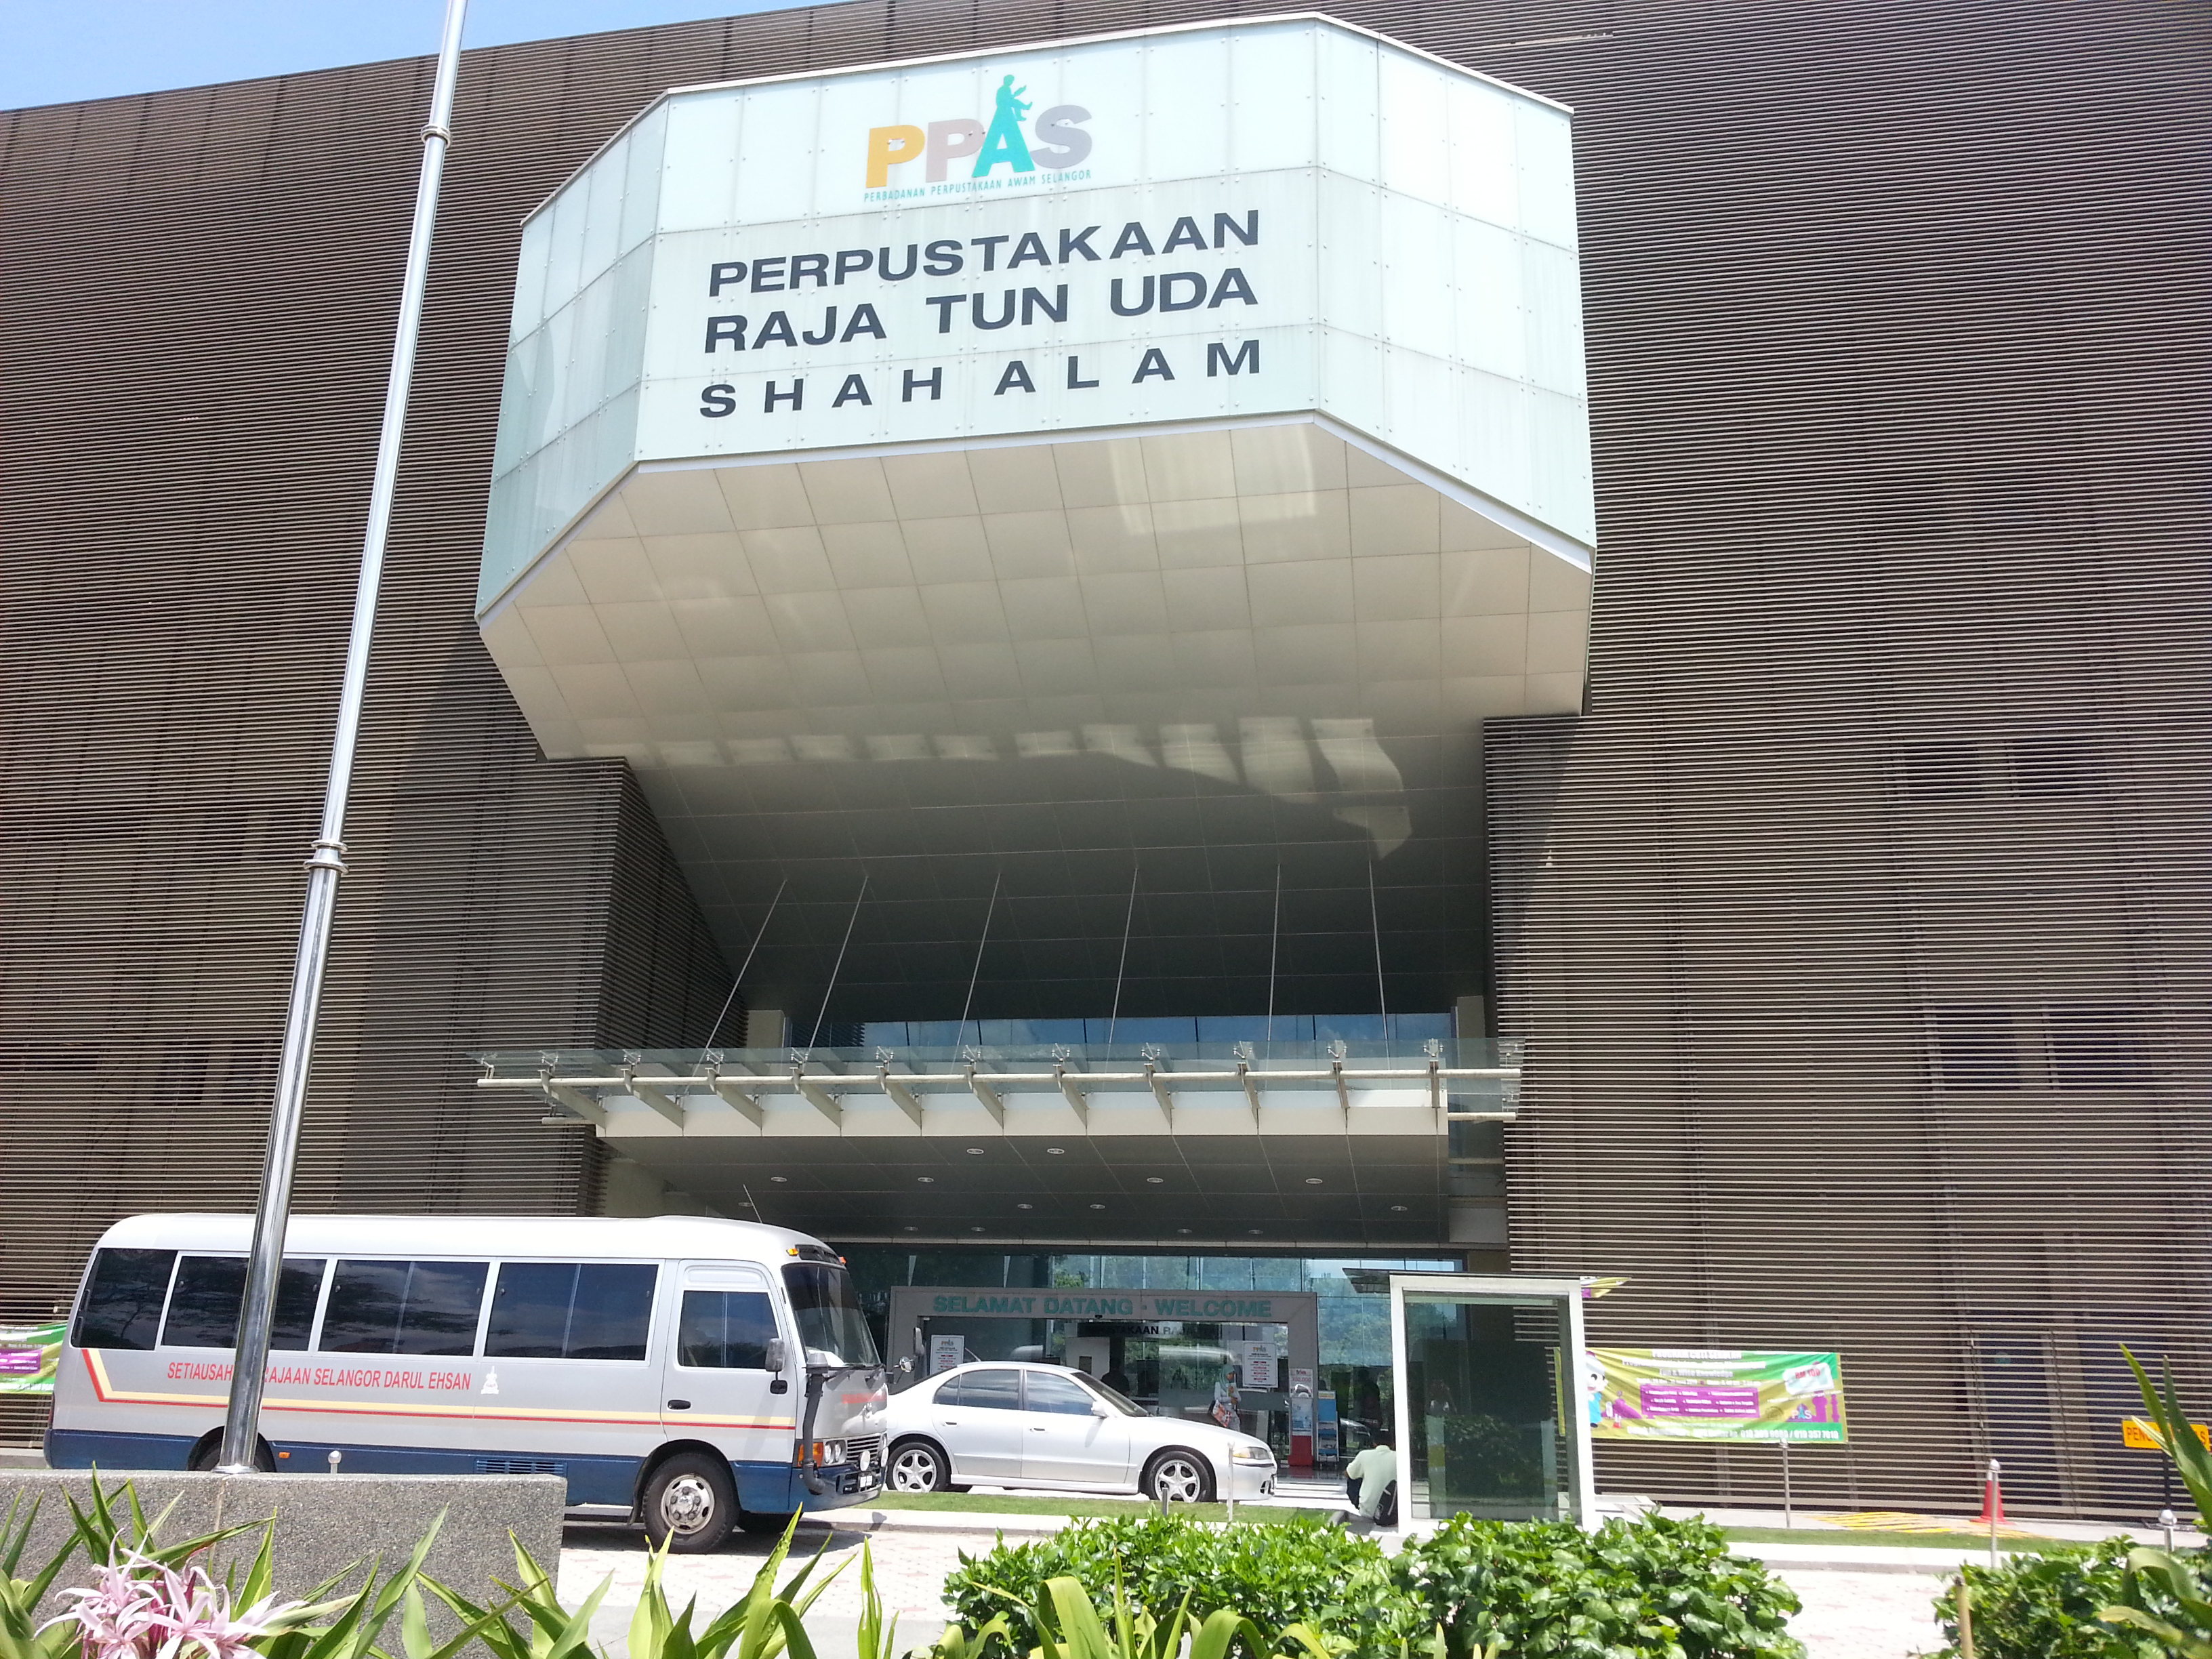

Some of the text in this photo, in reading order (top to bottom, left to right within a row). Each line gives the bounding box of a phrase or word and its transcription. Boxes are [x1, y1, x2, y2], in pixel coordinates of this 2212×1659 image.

[865, 104, 1092, 188] PPAS
[864, 169, 1092, 202] PERBADANAN PERPUSTAKAAN AWAM SELANGOR
[709, 209, 1258, 297] PERPUSTAKAAN
[704, 267, 1258, 354] RAJA TUN UDA
[699, 340, 1260, 418] SHAH ALAM
[933, 1295, 1272, 1317] SELAMAT DATANG WELCOME
[167, 1361, 234, 1380] SETIAUSAH
[314, 1368, 382, 1387] SELANGOR
[384, 1371, 424, 1389] DARUL
[428, 1372, 472, 1390] EHSAN
